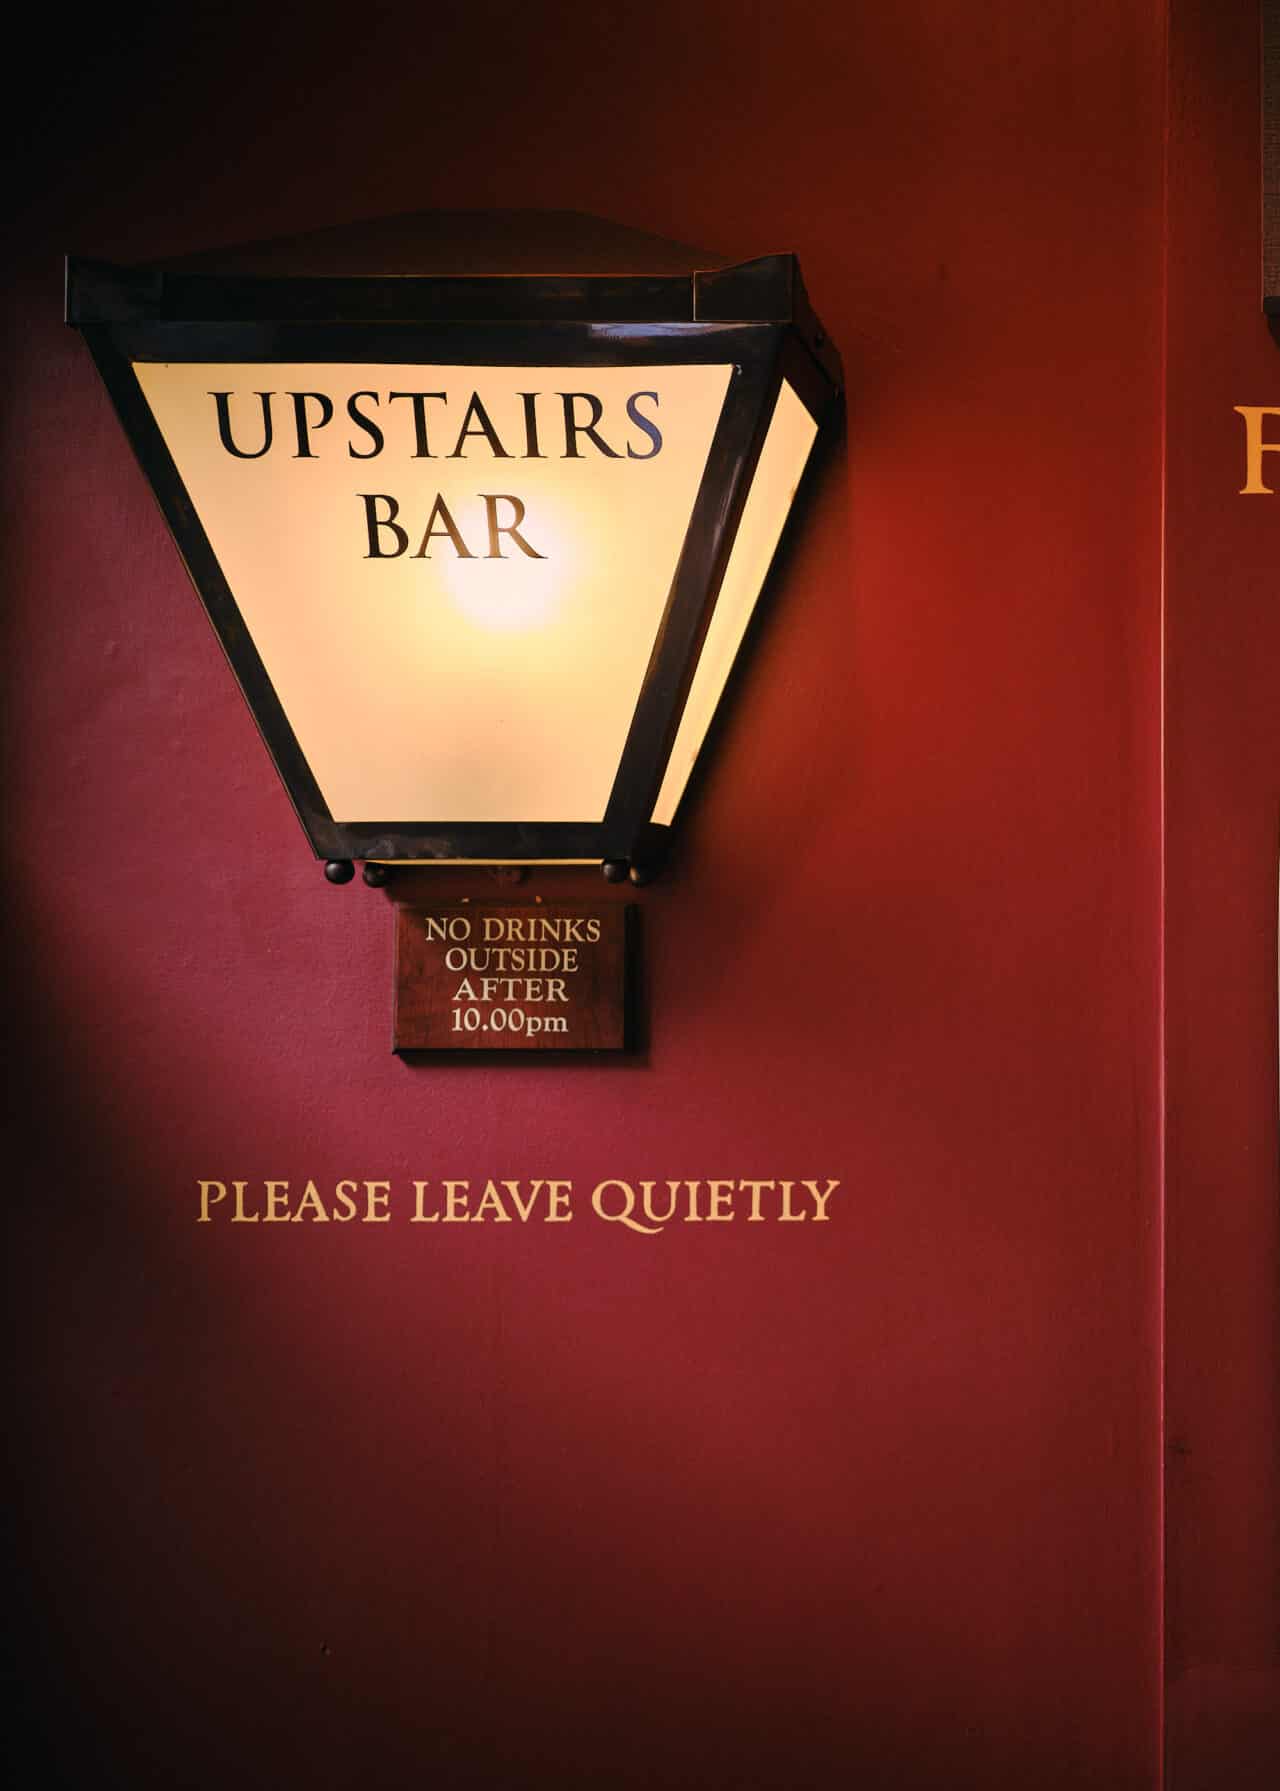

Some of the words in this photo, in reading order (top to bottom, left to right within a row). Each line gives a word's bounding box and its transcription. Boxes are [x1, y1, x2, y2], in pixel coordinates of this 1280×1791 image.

[207, 390, 663, 460] UPSTAIRS
[355, 492, 548, 559] BAR
[424, 917, 471, 942] NO
[483, 917, 601, 943] DRINKS
[445, 947, 579, 972] OUTSIDE
[451, 977, 570, 1002] AFTER
[451, 1007, 569, 1038] 10.00pm
[197, 1180, 391, 1223] PLEASE
[410, 1179, 573, 1223] LEAVE
[591, 1179, 841, 1235] QUIETLY
